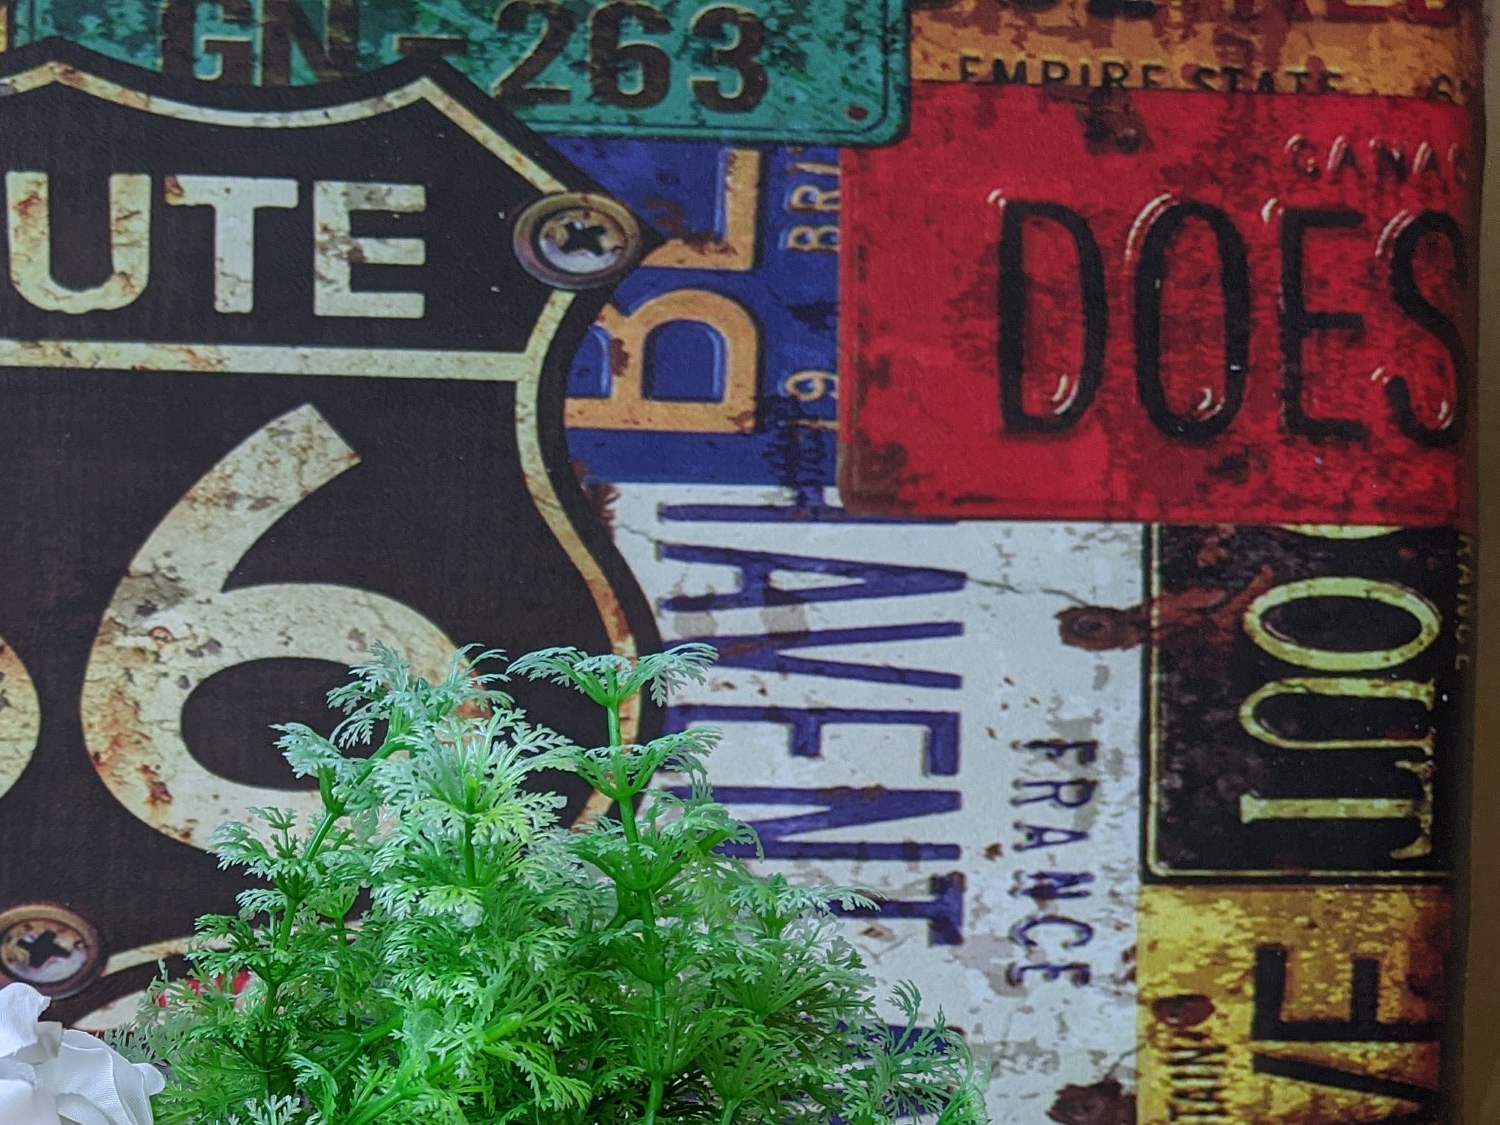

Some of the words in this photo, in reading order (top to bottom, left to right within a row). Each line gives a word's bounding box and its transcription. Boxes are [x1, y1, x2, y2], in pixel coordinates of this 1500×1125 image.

[988, 189, 1467, 449] DOES
[1238, 524, 1441, 859] OUT
[1008, 739, 1098, 988] FRANCE
